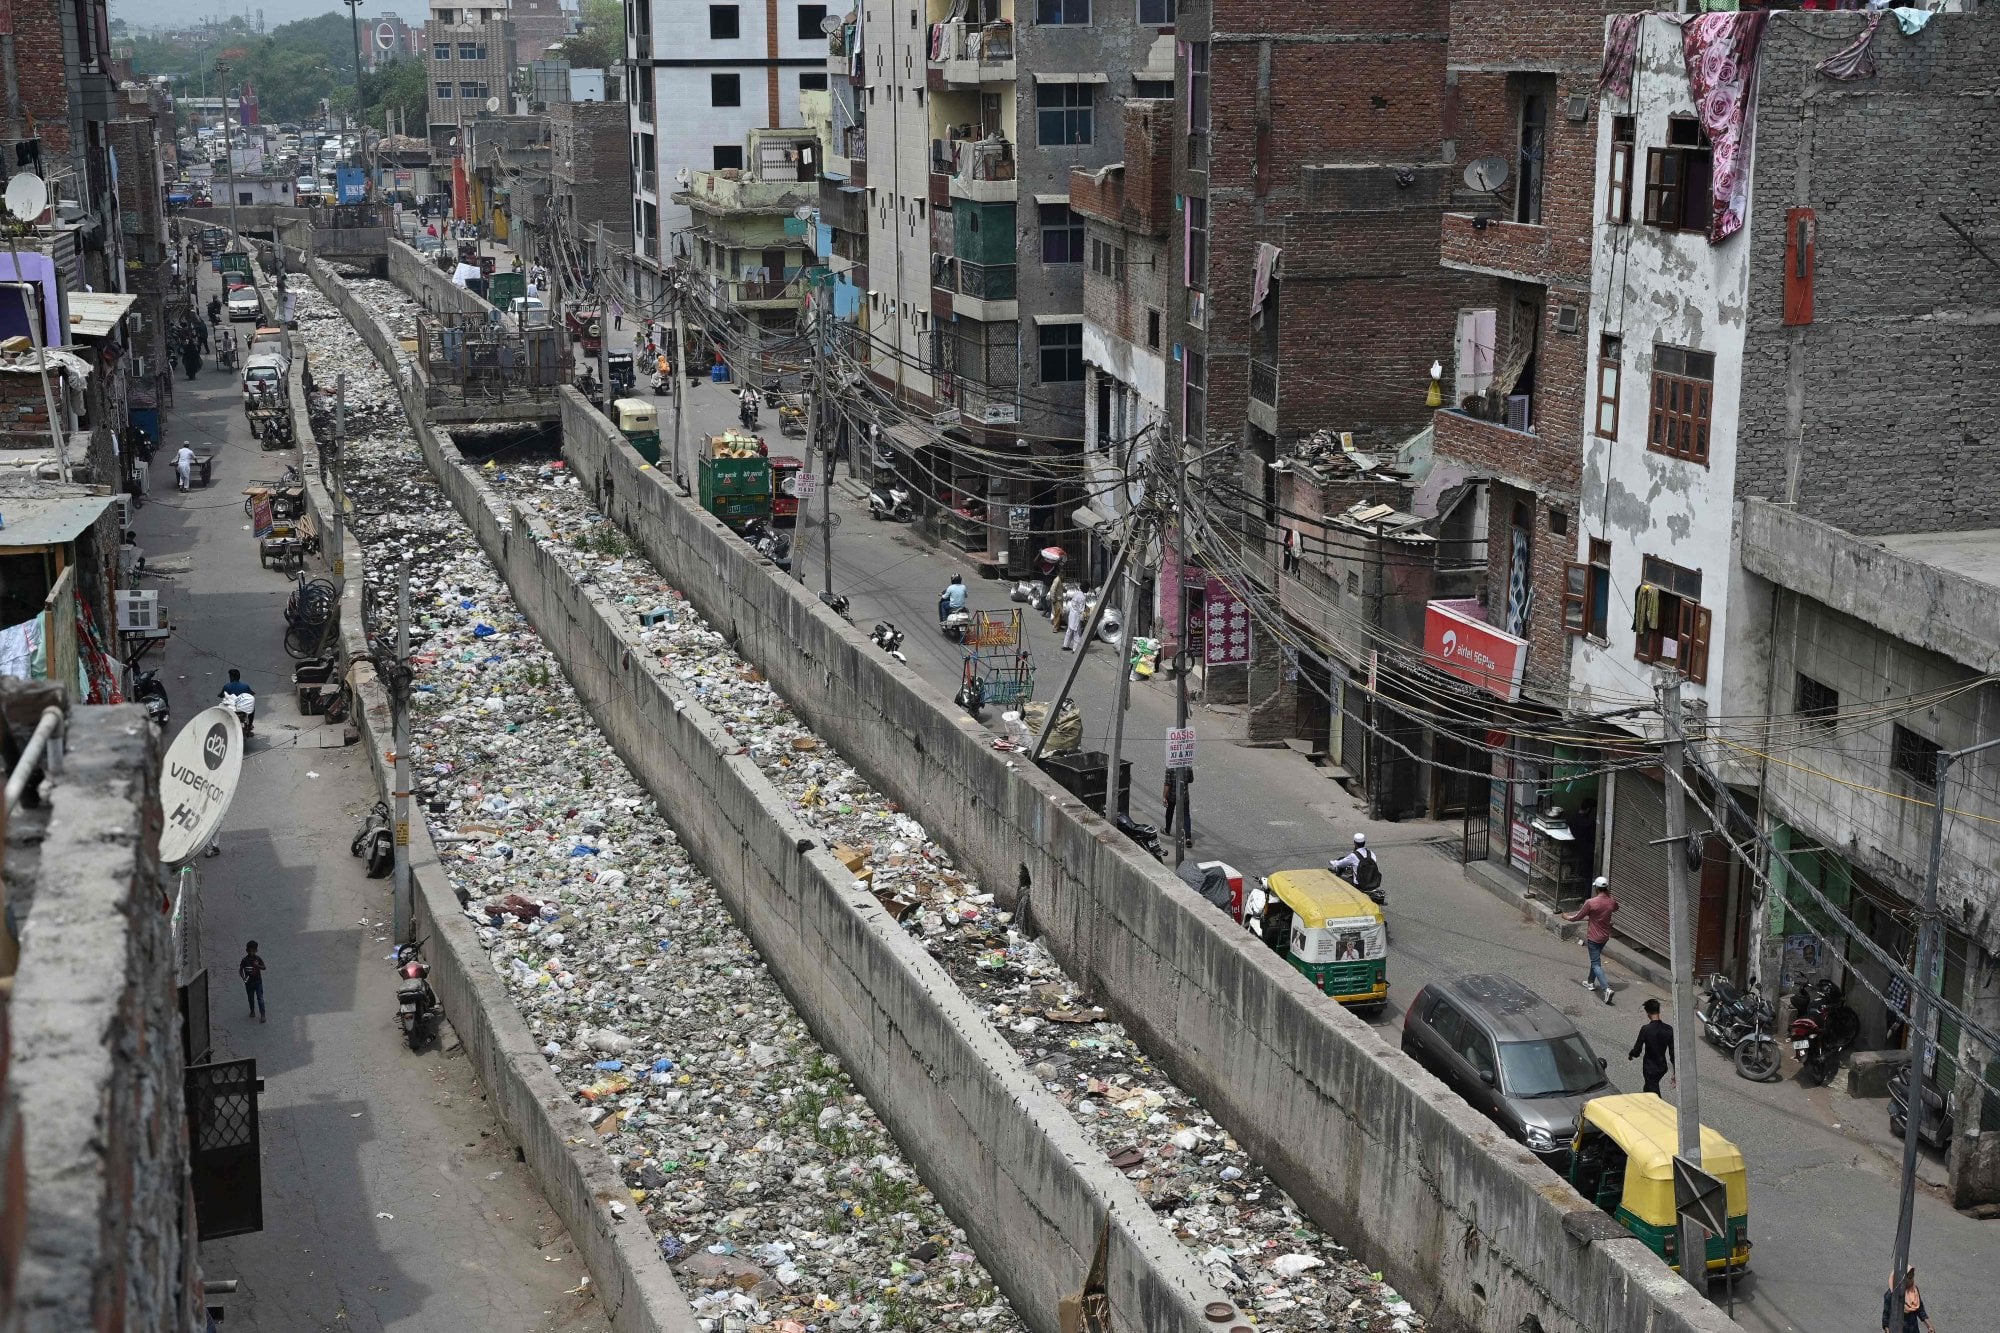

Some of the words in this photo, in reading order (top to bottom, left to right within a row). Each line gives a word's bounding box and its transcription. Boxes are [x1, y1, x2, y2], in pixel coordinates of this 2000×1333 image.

[1456, 643, 1473, 661] airtel
[206, 733, 227, 760] d2h
[1170, 730, 1194, 741] OASIS
[169, 802, 201, 832] HD
